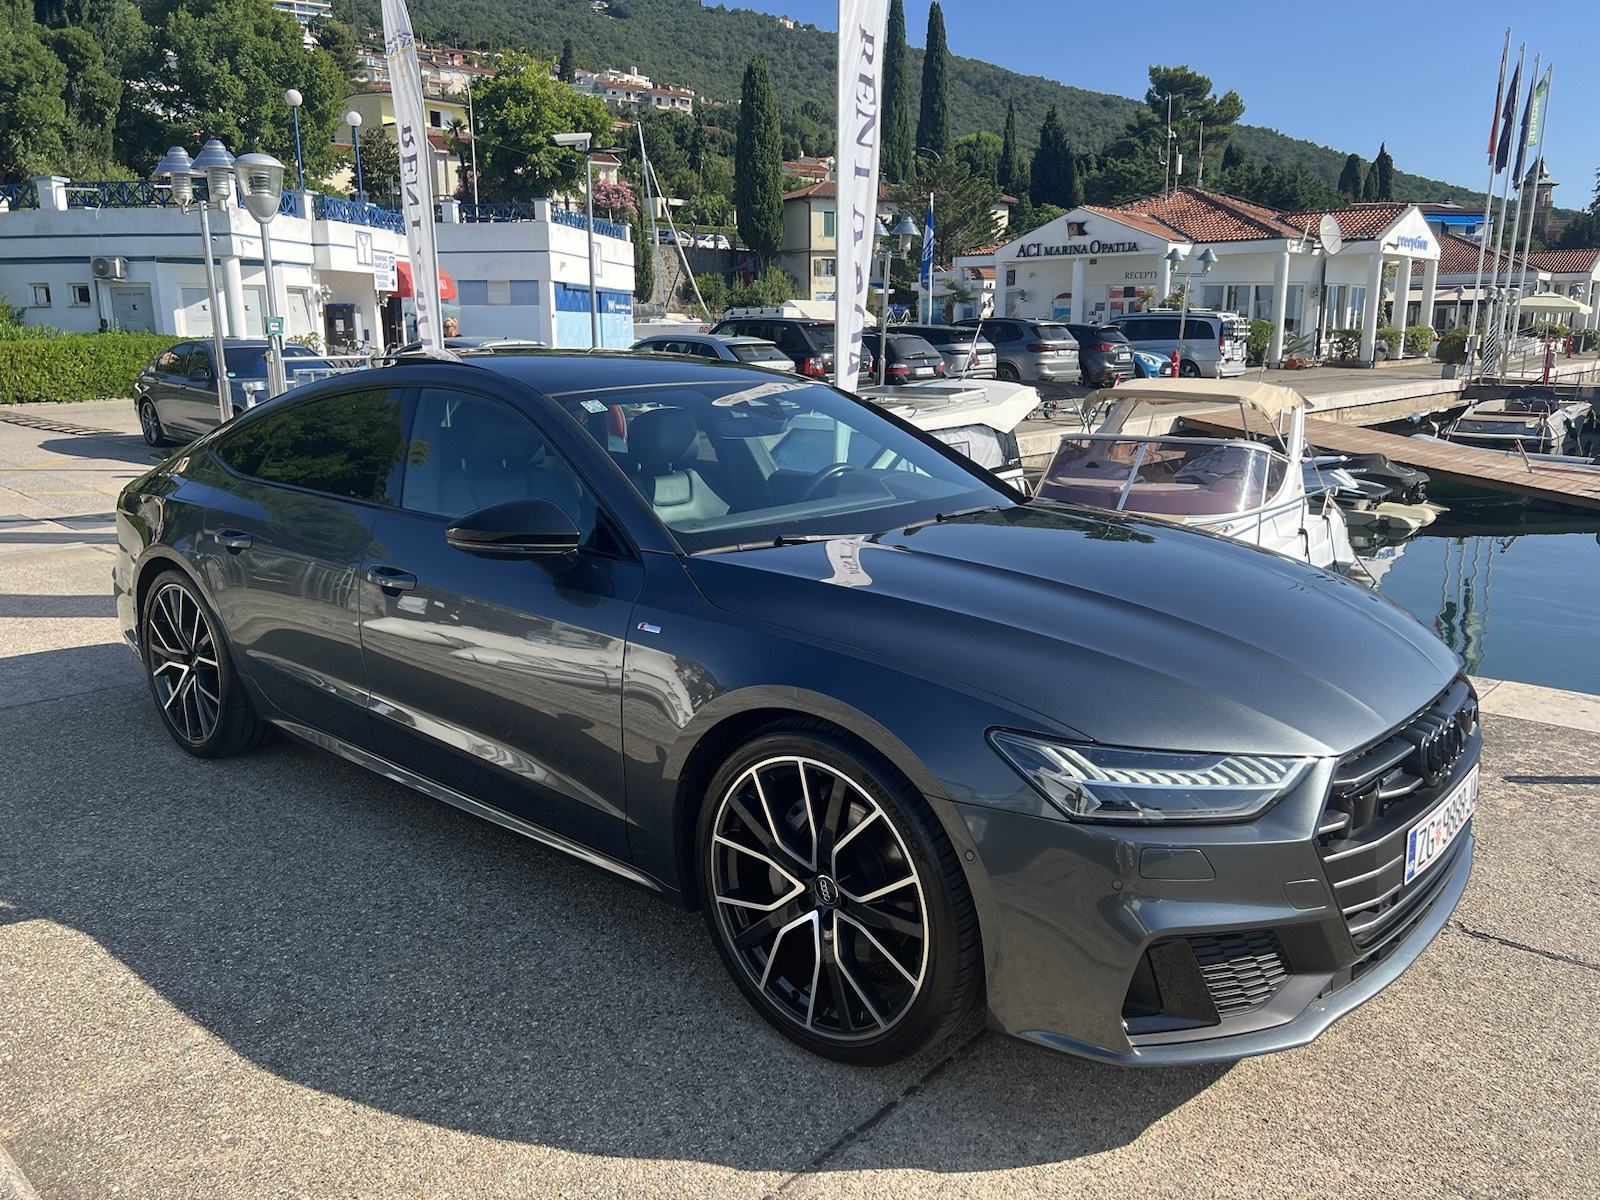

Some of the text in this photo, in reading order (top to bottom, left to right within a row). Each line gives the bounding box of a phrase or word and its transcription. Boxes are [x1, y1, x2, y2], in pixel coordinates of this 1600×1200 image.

[1016, 240, 1139, 258] ACI MARINA OPATIJA
[1124, 271, 1159, 280] RECEPTI
[1417, 820, 1435, 867] ZG
